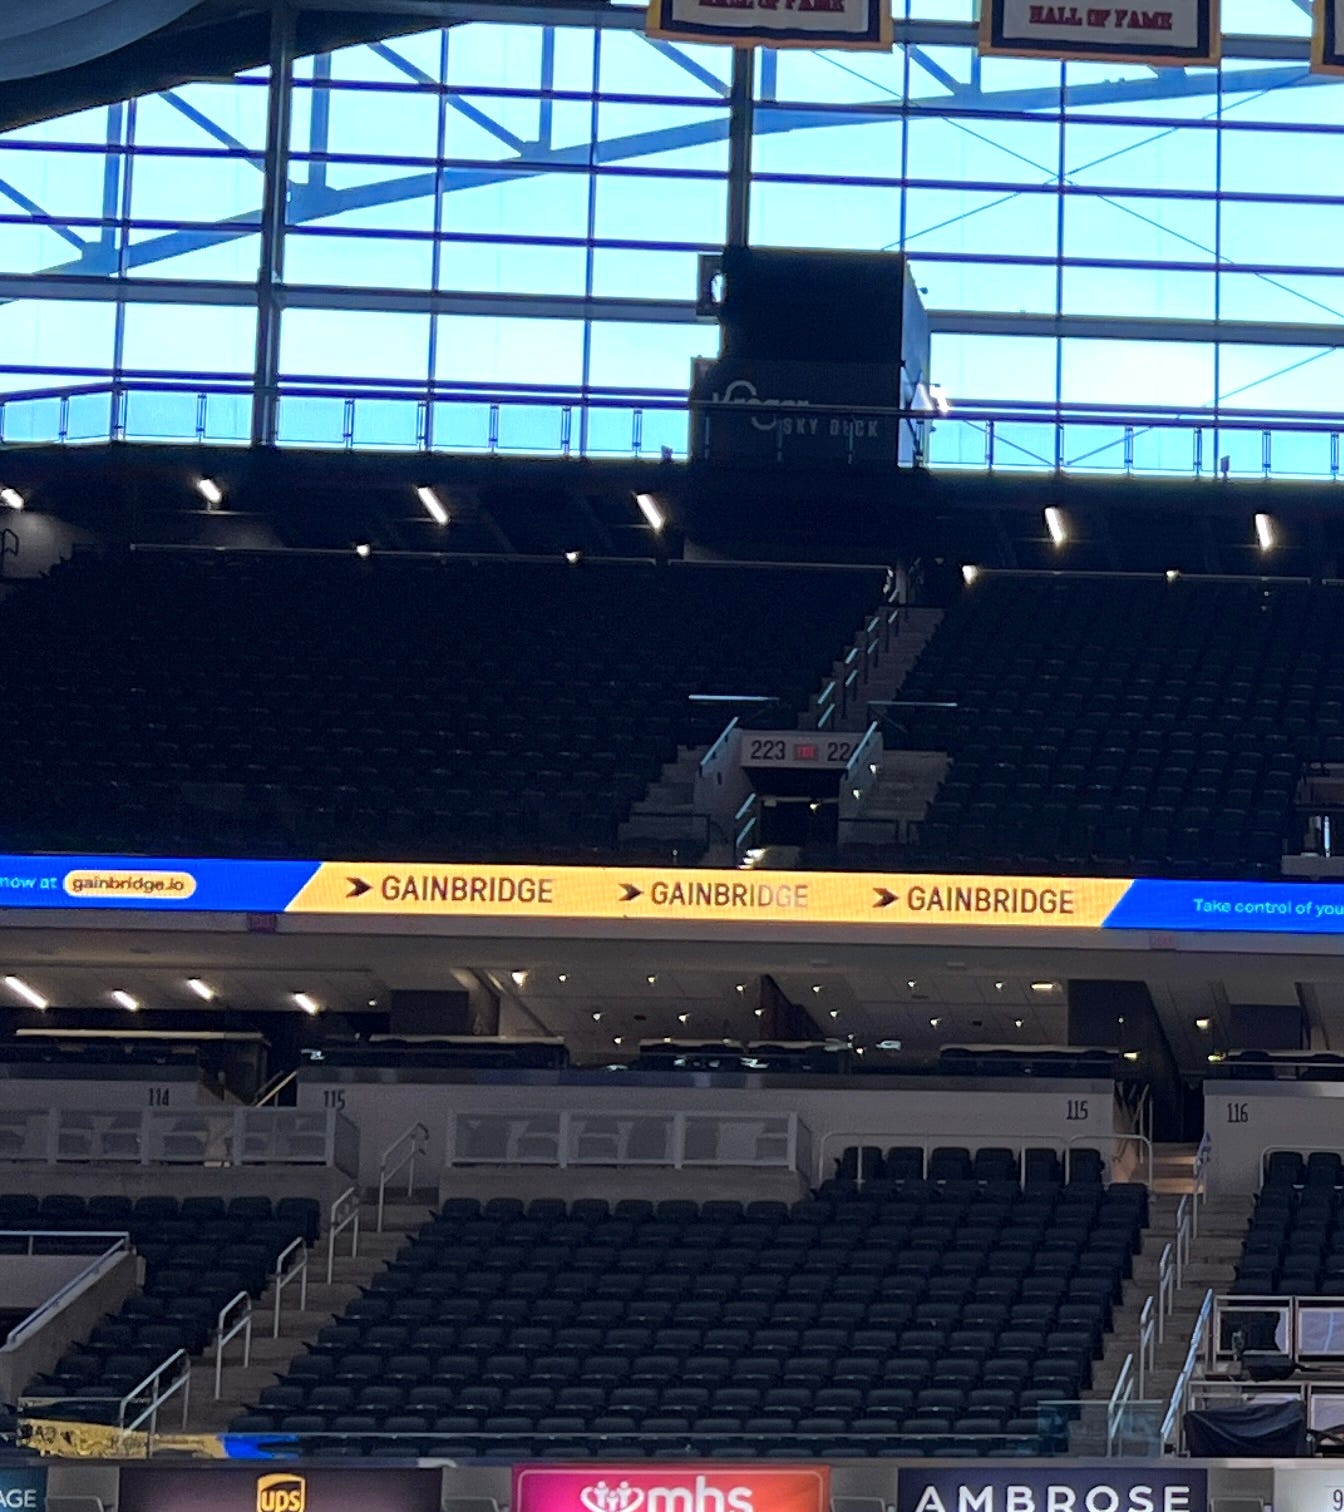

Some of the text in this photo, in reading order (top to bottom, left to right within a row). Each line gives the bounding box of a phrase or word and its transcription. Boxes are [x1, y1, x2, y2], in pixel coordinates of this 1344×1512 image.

[1029, 5, 1173, 30] HALL OF FAME
[751, 740, 785, 760] 223
[827, 742, 856, 762] 22
[39, 876, 57, 889] at
[72, 874, 184, 895] gainbridge.io
[381, 875, 553, 904] GAINBRIDGE
[650, 880, 809, 909] GAINBRIDGE
[907, 886, 1075, 915] GAINBRIDGE
[1193, 898, 1231, 914] Take
[1234, 899, 1292, 915] control
[1295, 900, 1313, 915] of
[148, 1088, 171, 1107] 114
[323, 1089, 346, 1111] 115
[1066, 1099, 1089, 1121] 115
[1227, 1103, 1249, 1124] 116
